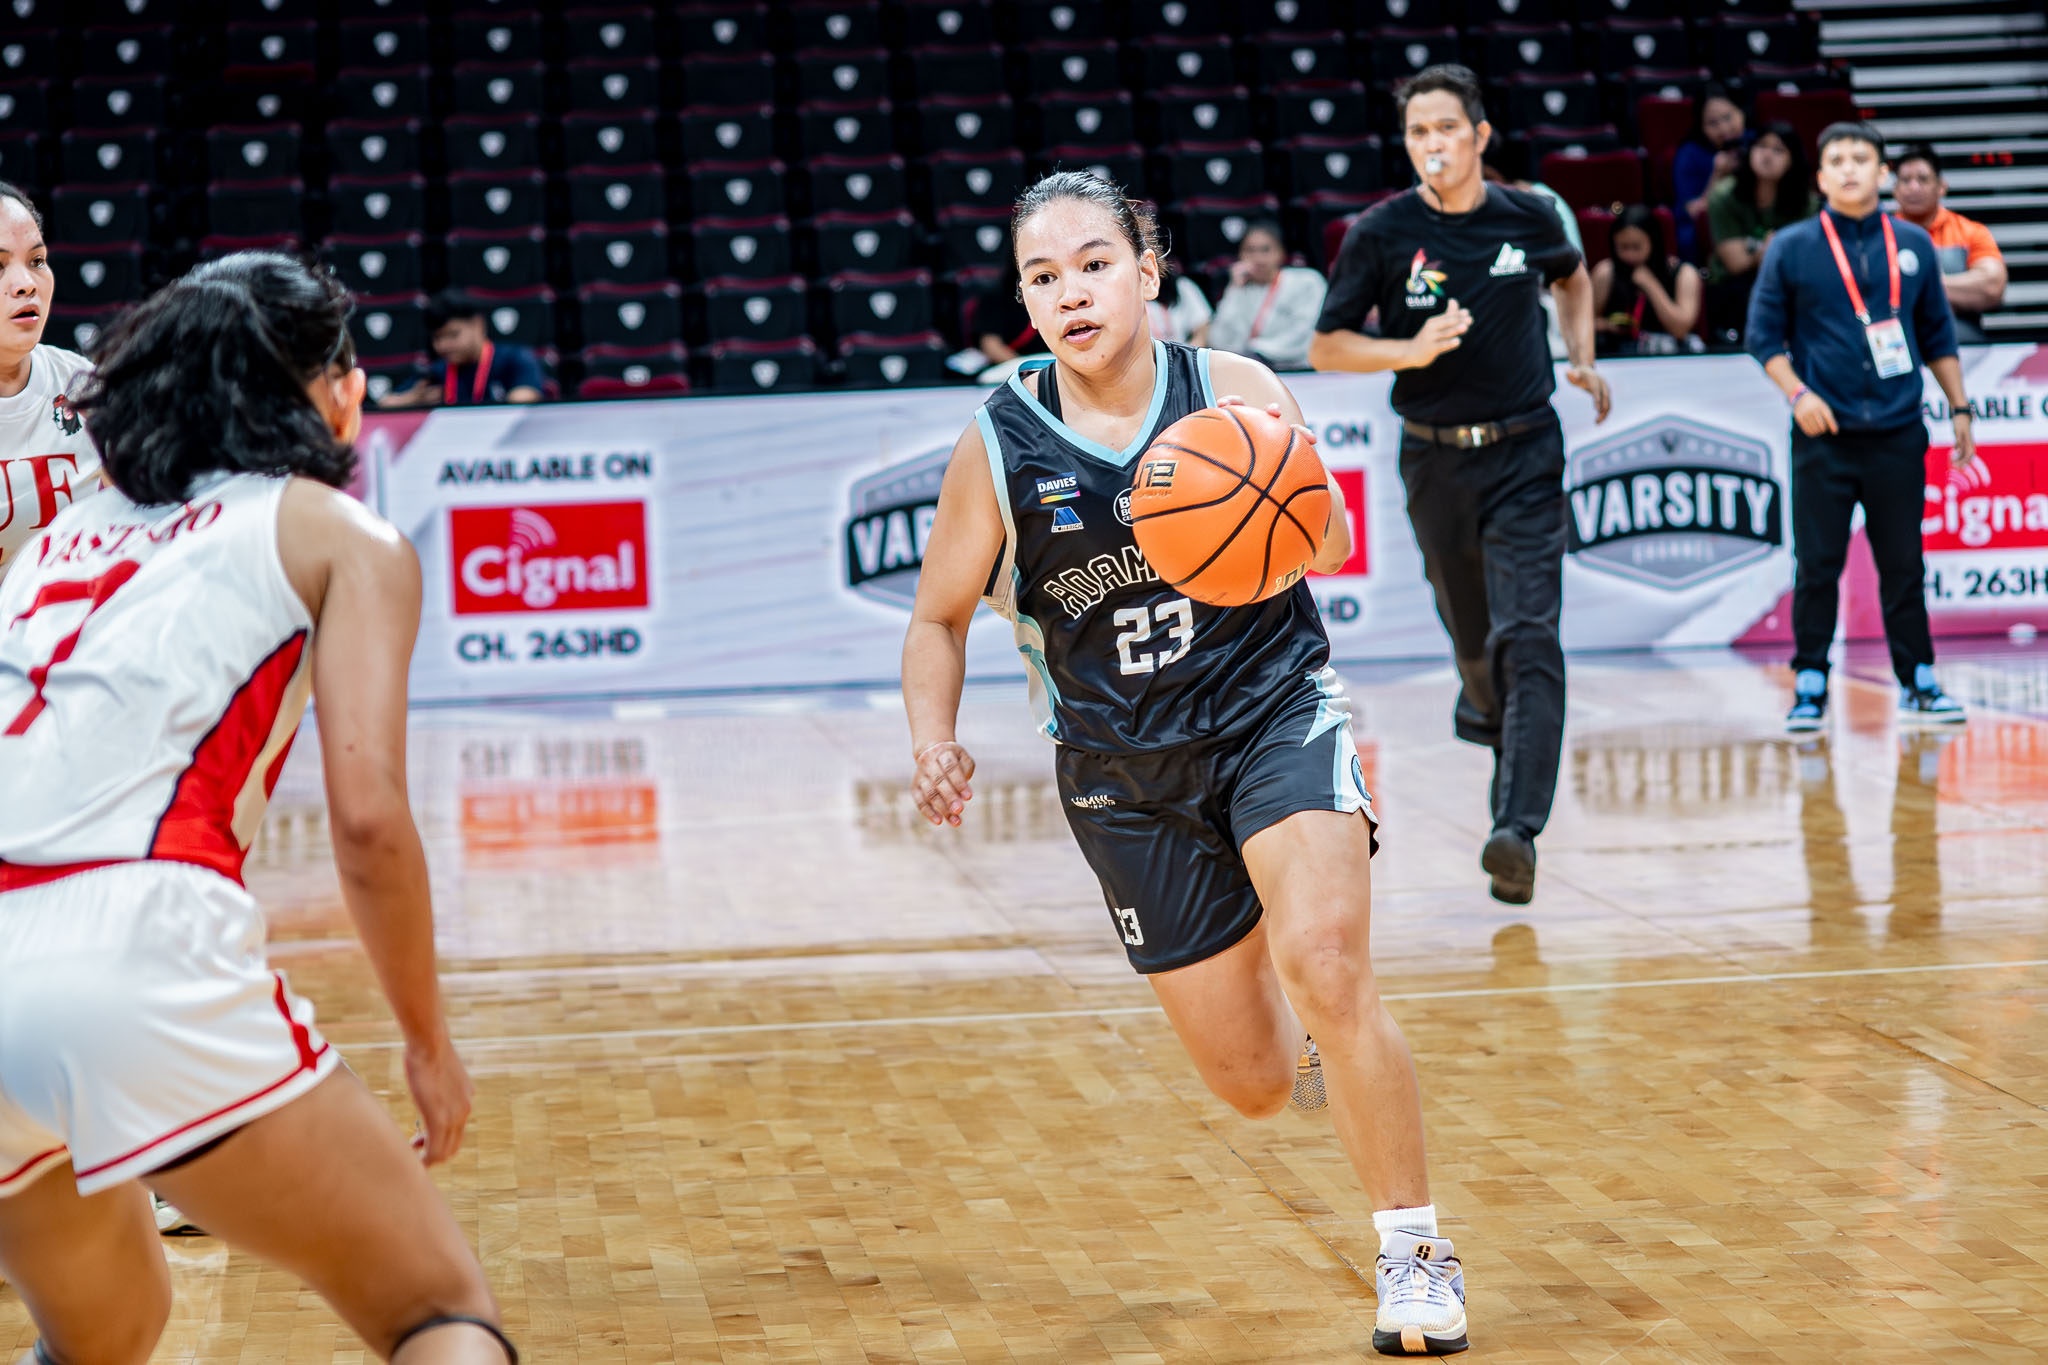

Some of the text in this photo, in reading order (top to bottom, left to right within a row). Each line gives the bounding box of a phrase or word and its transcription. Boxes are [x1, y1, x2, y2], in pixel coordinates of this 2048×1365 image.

[1325, 422, 1371, 448] ON
[438, 453, 652, 484] AVAILABLE ON
[1037, 477, 1077, 493] DAVIES
[1571, 471, 1774, 543] VARSITY
[461, 540, 637, 608] Cignal
[3, 559, 141, 735] 7
[457, 627, 642, 662] CH. 263HD
[1113, 598, 1195, 675] 23
